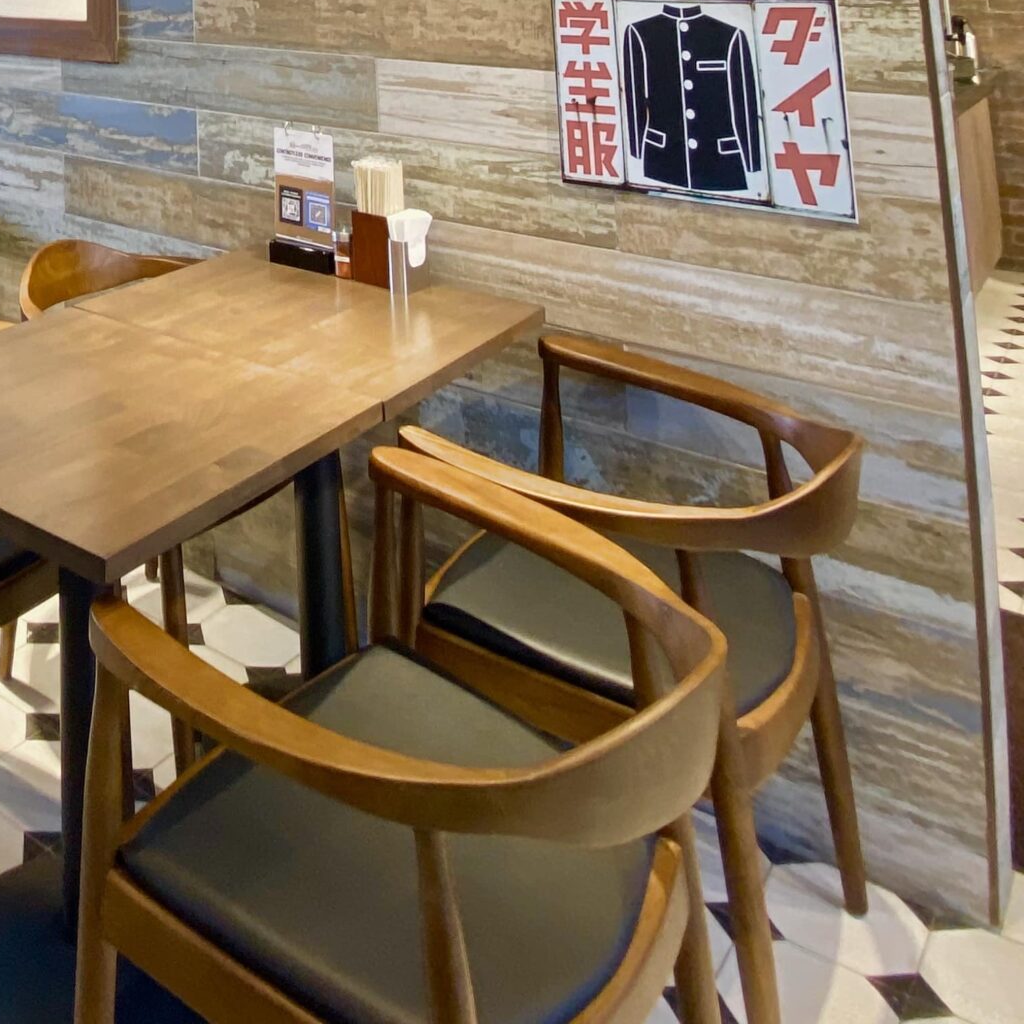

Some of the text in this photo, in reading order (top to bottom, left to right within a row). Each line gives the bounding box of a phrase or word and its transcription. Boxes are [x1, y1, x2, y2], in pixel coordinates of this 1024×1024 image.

[558, 1, 619, 177] 学生服
[761, 7, 840, 206] ダイヤ
